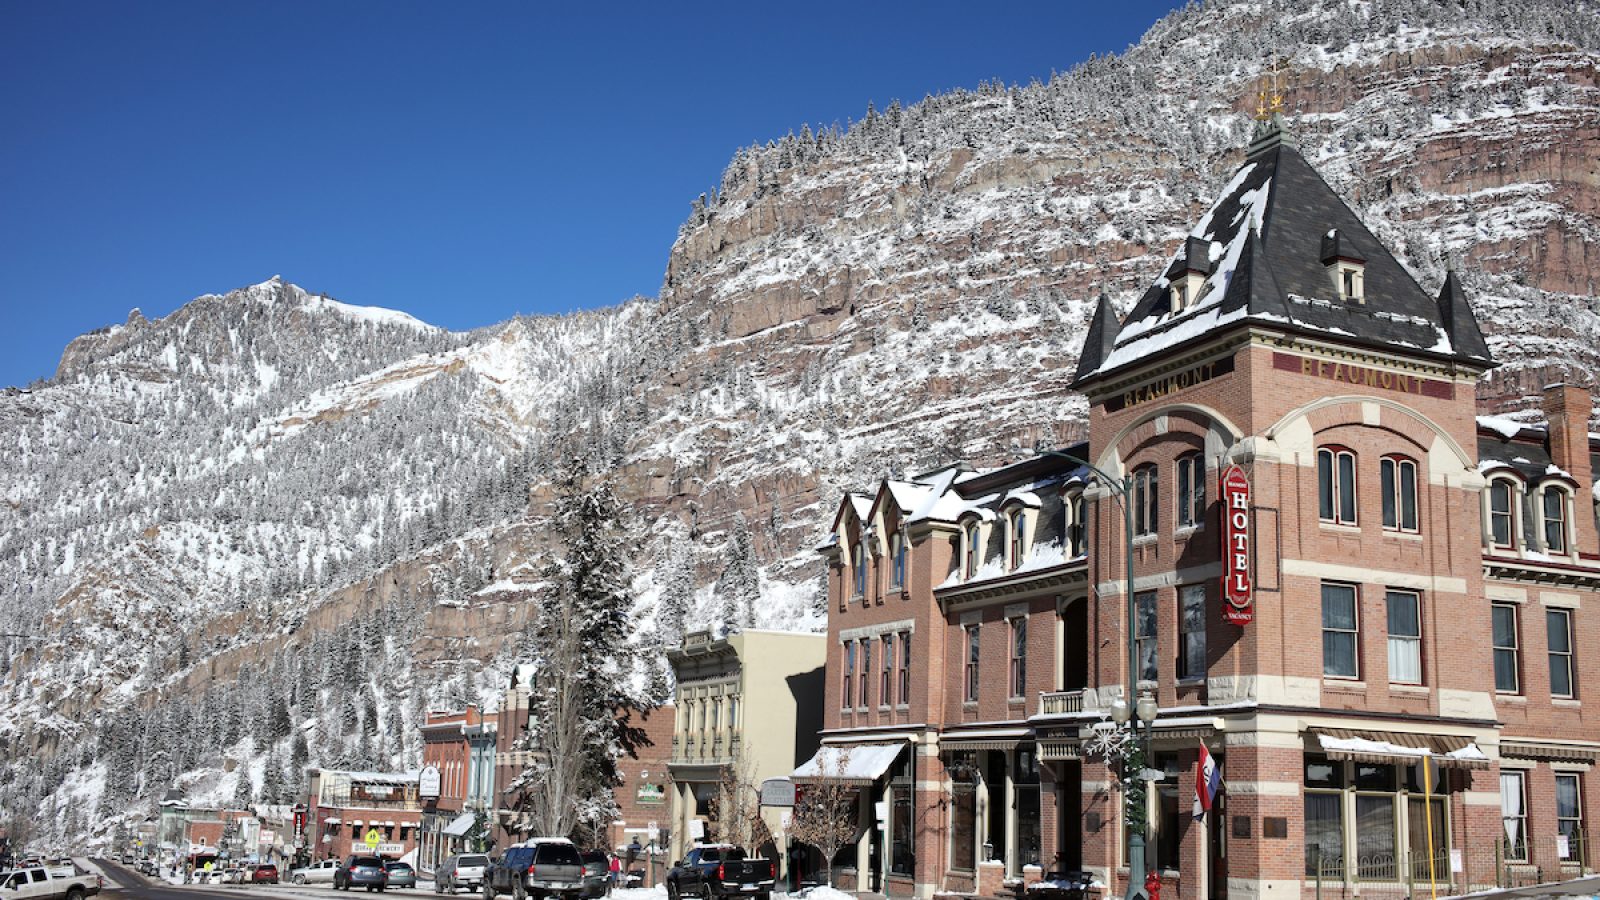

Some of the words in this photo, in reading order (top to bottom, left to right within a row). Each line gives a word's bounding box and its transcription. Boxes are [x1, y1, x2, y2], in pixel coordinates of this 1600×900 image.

[1124, 362, 1217, 408] BEAUMONT
[1302, 357, 1426, 394] BEAUMONT
[1231, 491, 1248, 592] HOTEL
